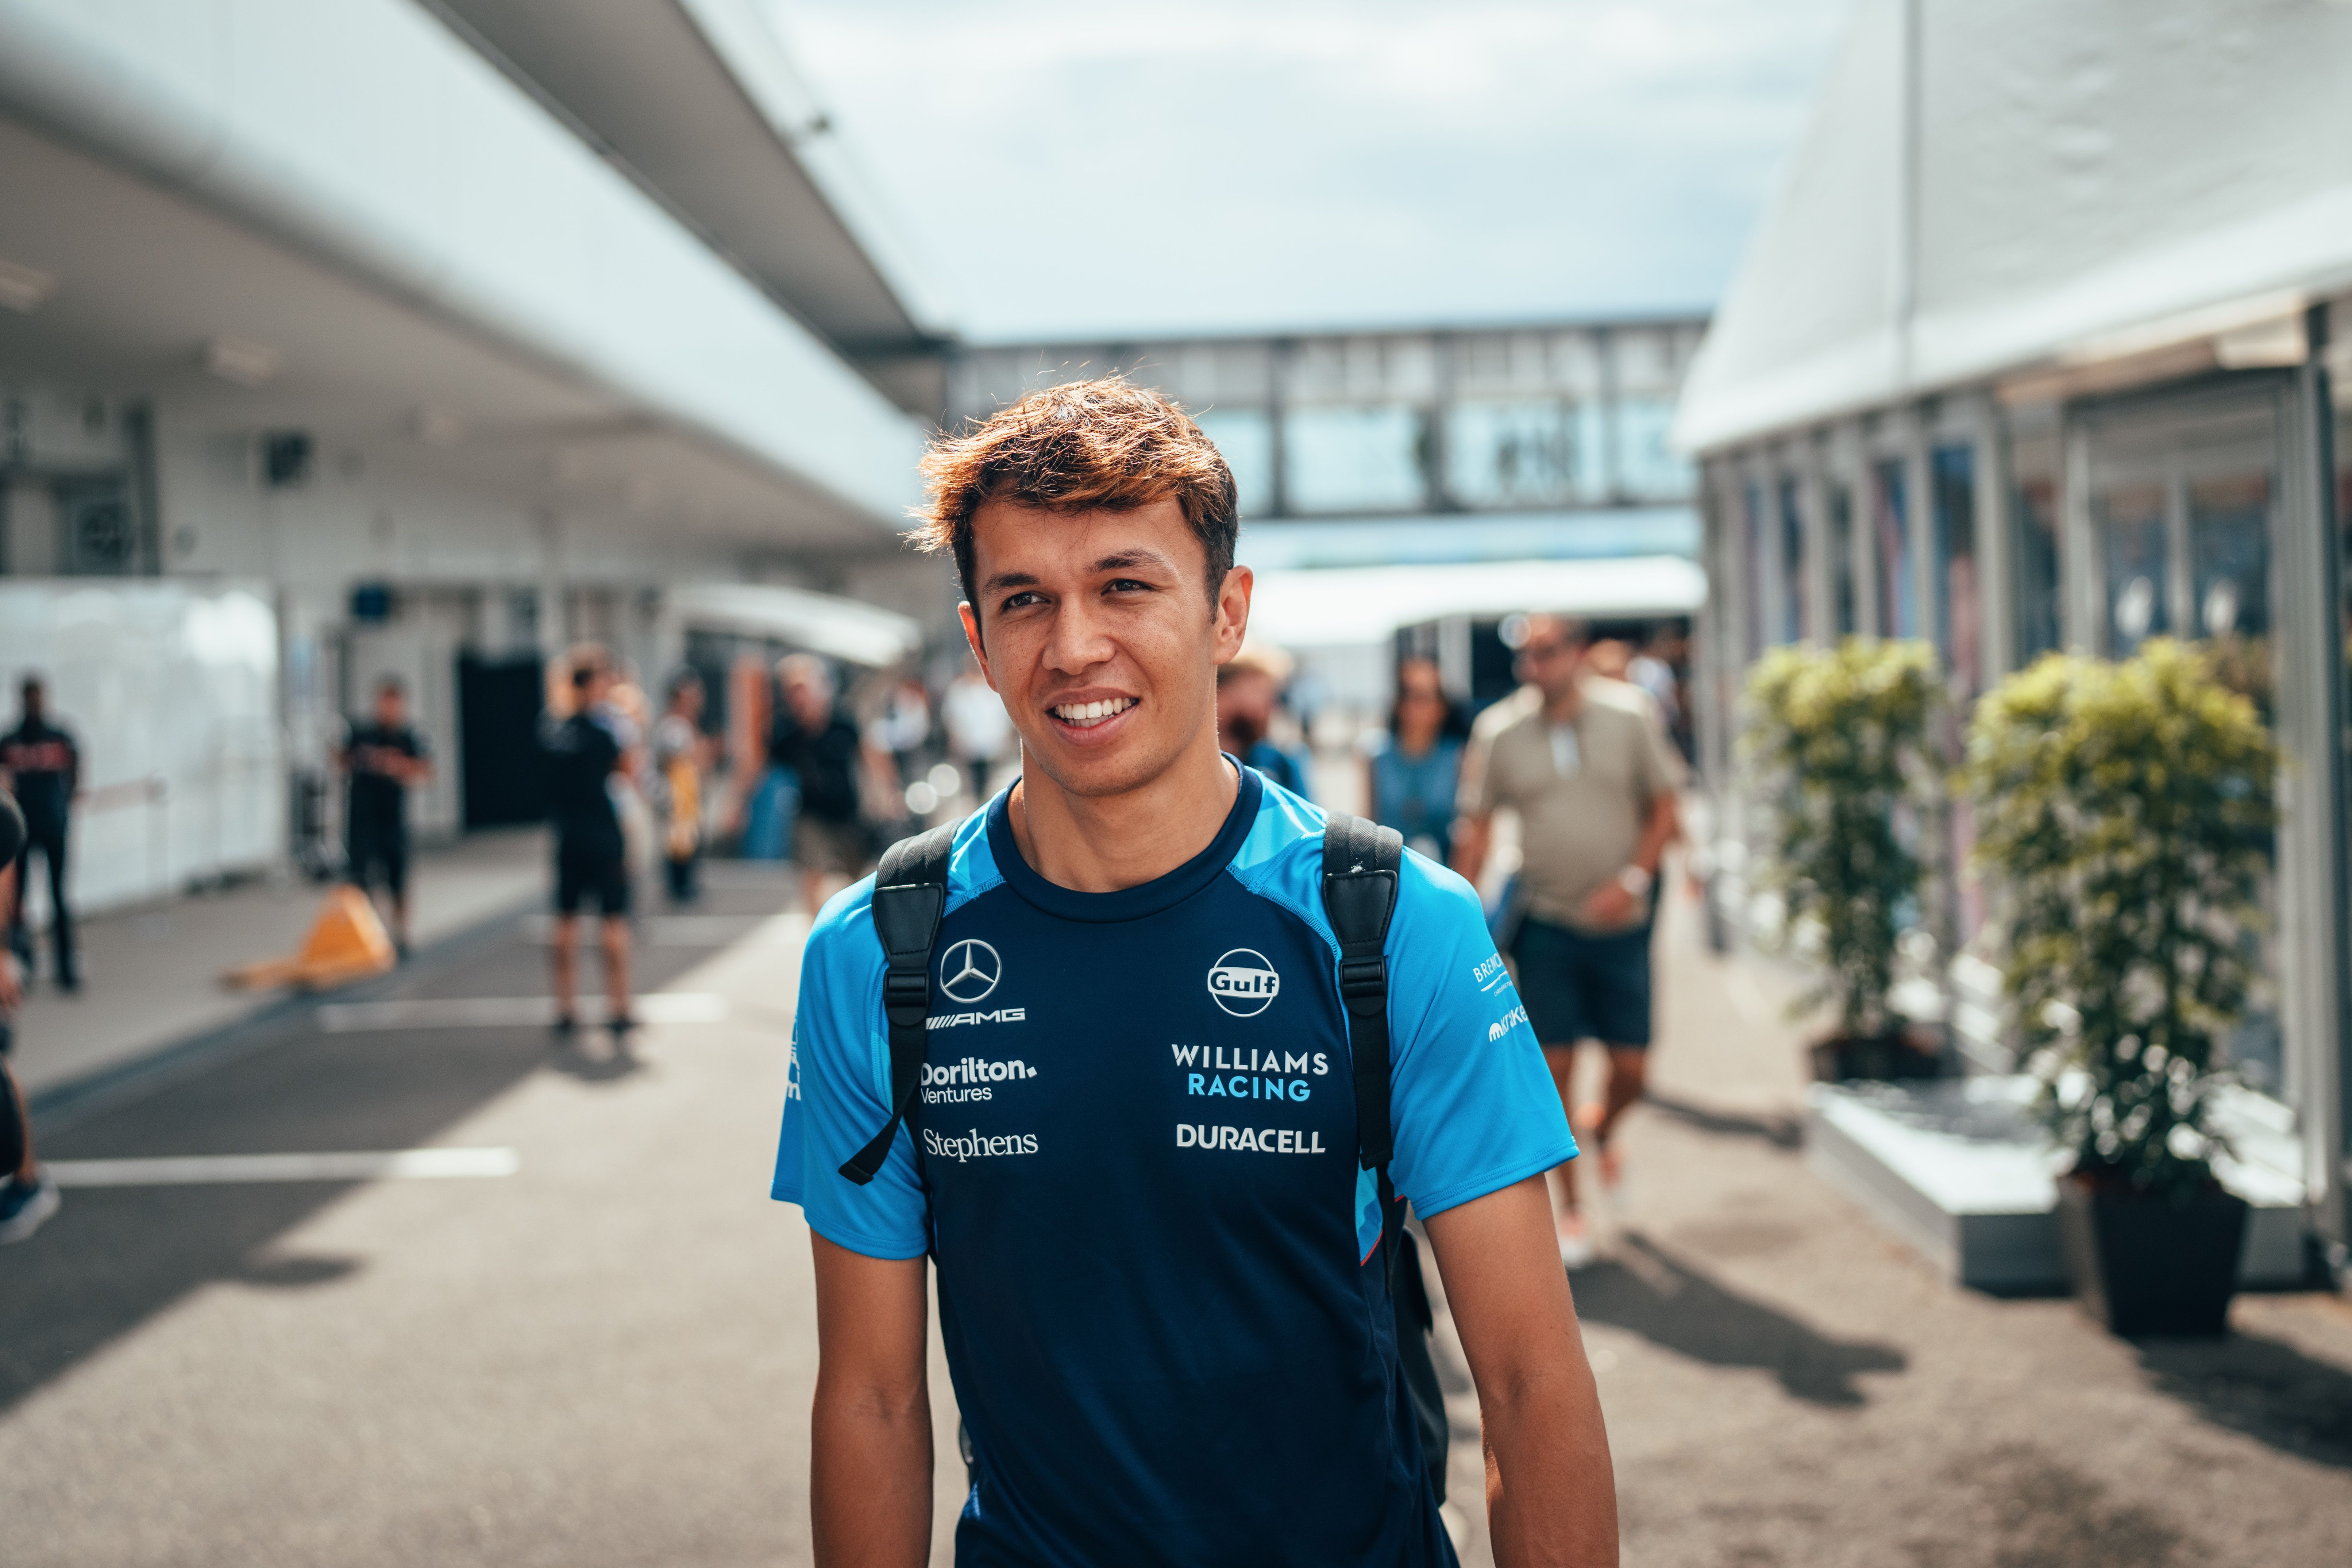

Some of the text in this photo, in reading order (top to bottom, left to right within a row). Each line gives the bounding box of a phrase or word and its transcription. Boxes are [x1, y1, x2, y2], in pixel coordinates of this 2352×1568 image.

[1473, 953, 1504, 982] BREMO
[1210, 971, 1276, 994] Gulf
[950, 1008, 1025, 1027] AMG
[1171, 1044, 1329, 1075] WILLIAMS
[921, 1087, 992, 1103] Ventures
[1188, 1073, 1310, 1102] RACING
[924, 1128, 1038, 1162] Stephens
[1176, 1124, 1326, 1153] DURACELL
